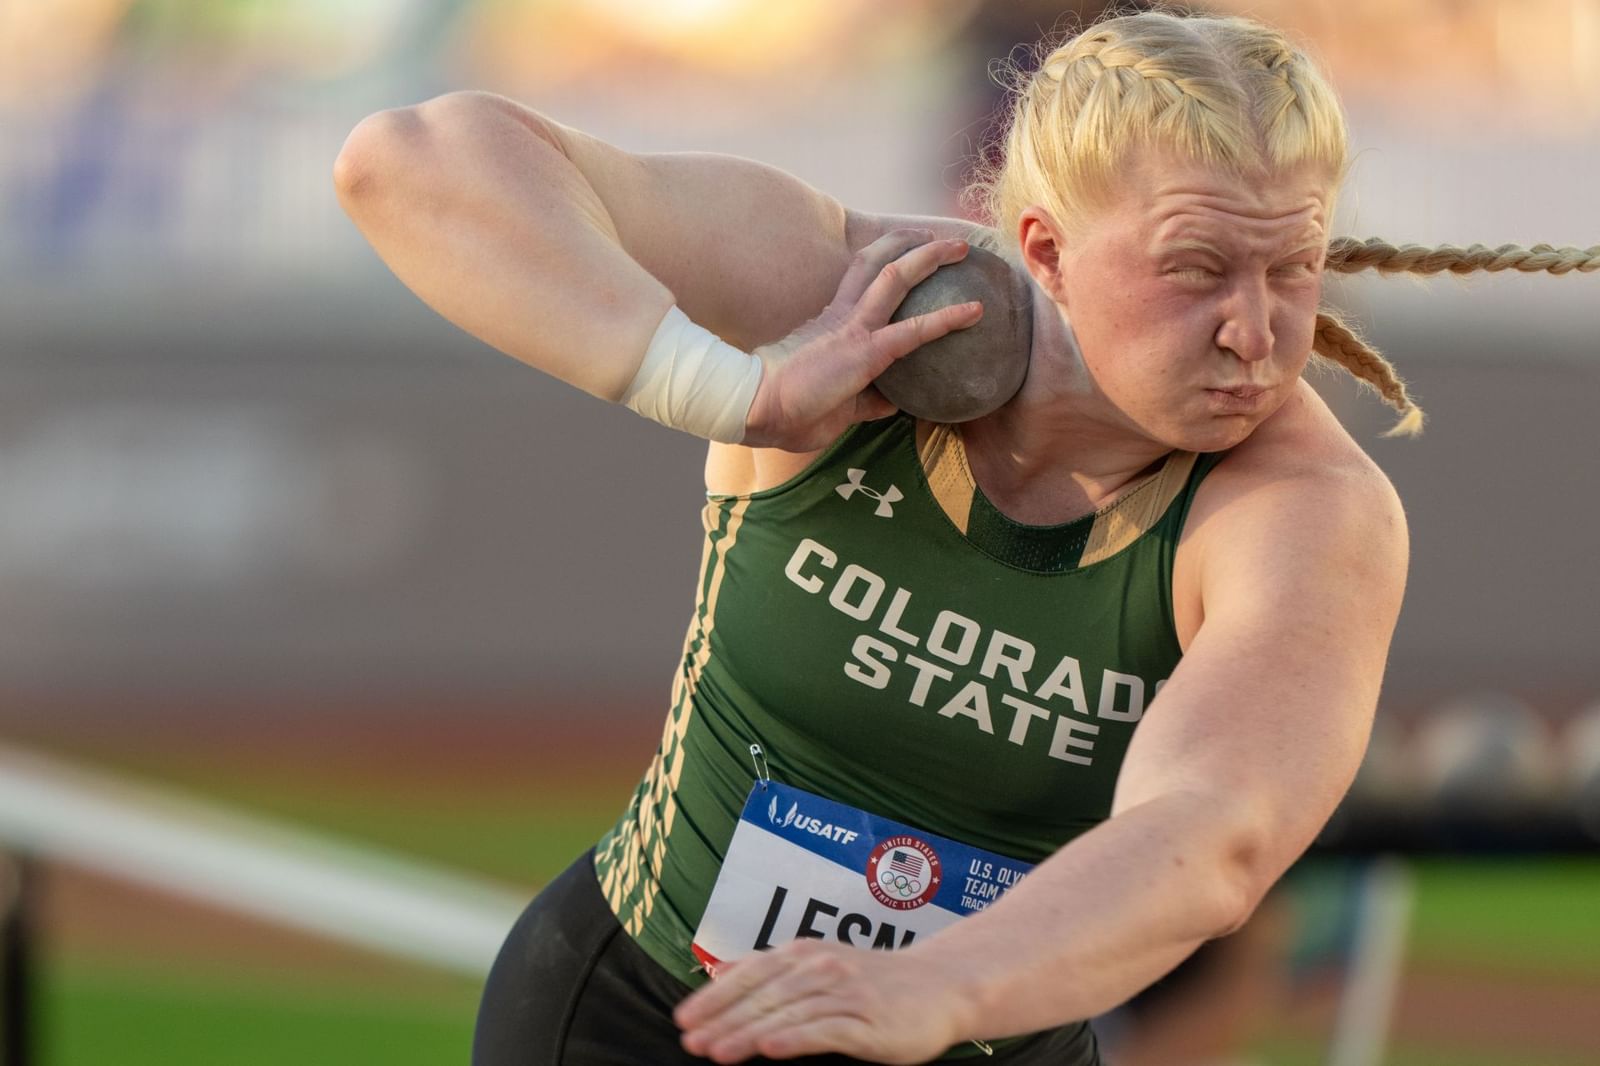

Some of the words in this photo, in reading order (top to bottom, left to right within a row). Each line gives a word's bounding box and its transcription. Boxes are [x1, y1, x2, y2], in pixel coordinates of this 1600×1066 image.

[784, 538, 1169, 723] COLORAD
[844, 634, 1100, 766] STATE
[794, 814, 858, 845] USATF
[881, 837, 912, 850] UNITED
[915, 841, 938, 866] STATES
[969, 859, 993, 880] U.S.
[997, 867, 1026, 887] OLY
[870, 881, 898, 908] OLYMPIC
[902, 897, 925, 909] TEAM
[964, 877, 999, 900] TEAM
